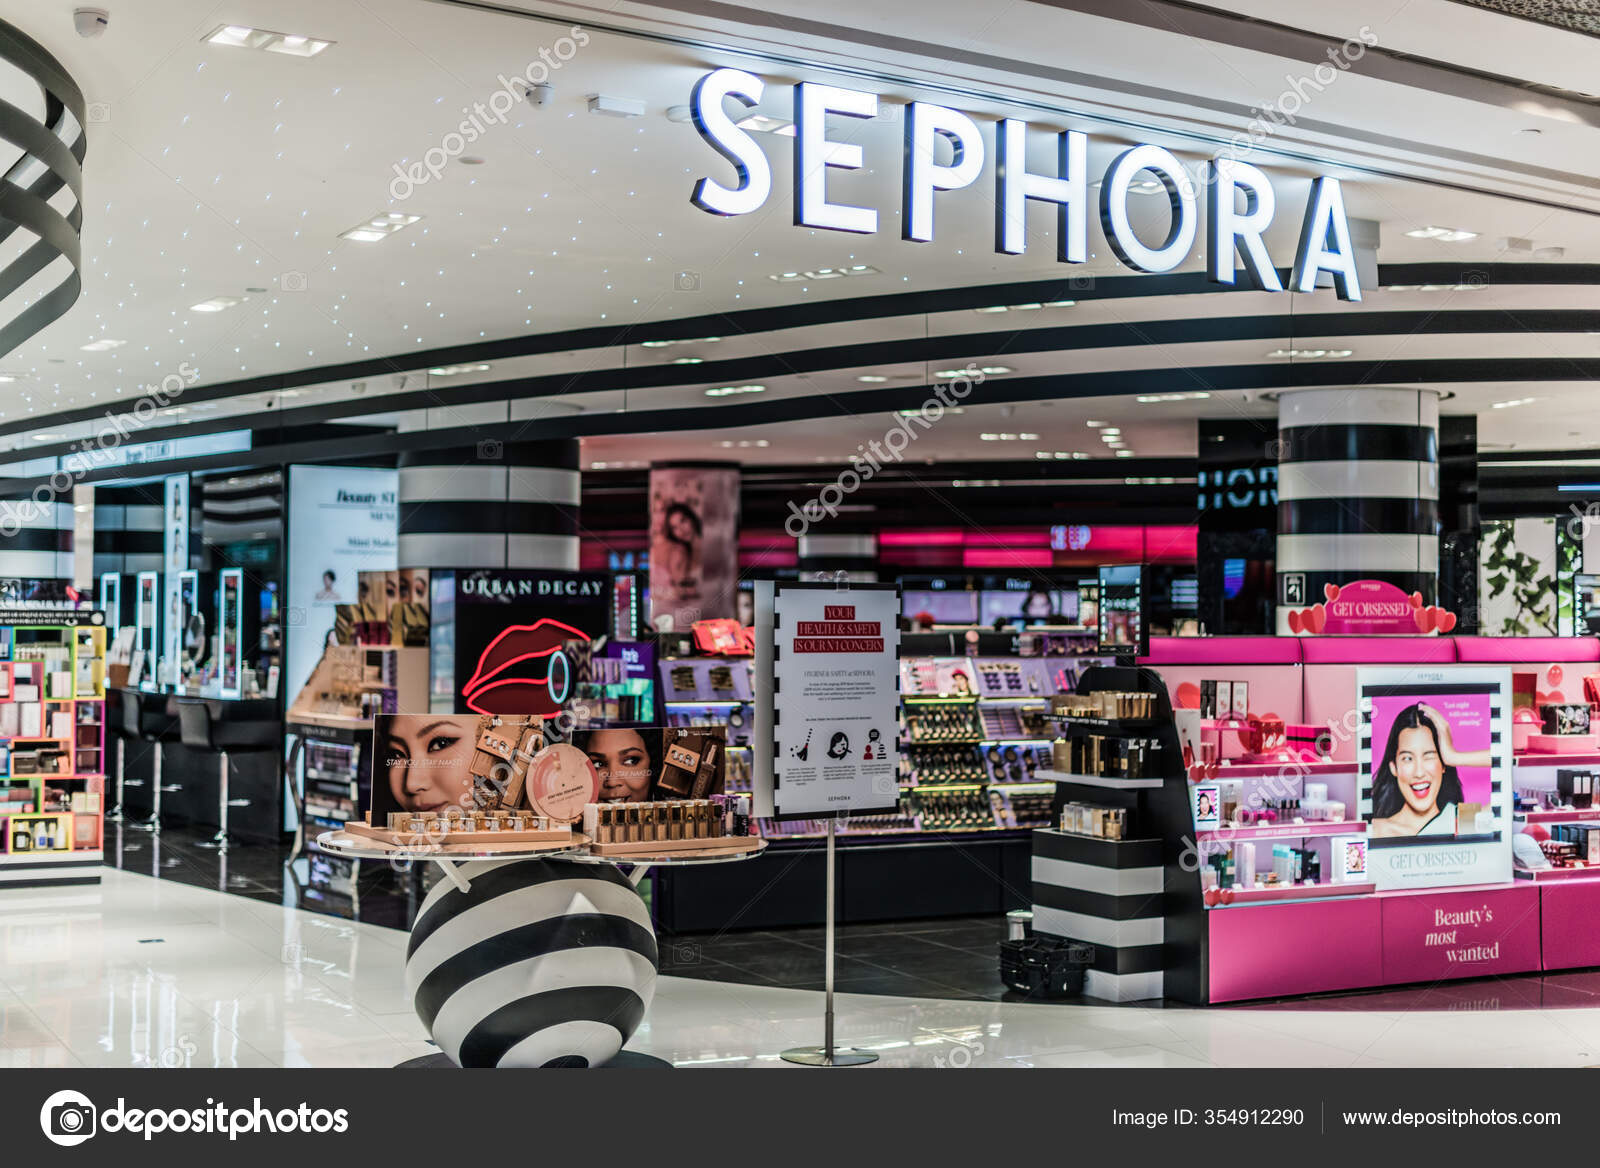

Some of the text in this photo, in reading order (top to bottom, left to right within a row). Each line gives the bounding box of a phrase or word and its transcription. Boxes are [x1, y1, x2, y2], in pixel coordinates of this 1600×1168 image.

[690, 67, 1363, 302] SEPHORA
[461, 573, 604, 602] URBAN DECAY
[826, 606, 854, 619] YOUR
[1332, 600, 1411, 617] GET OBSESSED
[799, 622, 880, 635] HEALTH & SAFETY
[793, 639, 803, 652] IS
[803, 639, 826, 652] OUR
[840, 638, 883, 652] CONCERN
[385, 758, 402, 767] STAY
[1389, 850, 1478, 870] GET OBSESSED
[1434, 904, 1493, 928] Beauty's
[1425, 930, 1457, 946] most
[1446, 942, 1500, 963] wanted
